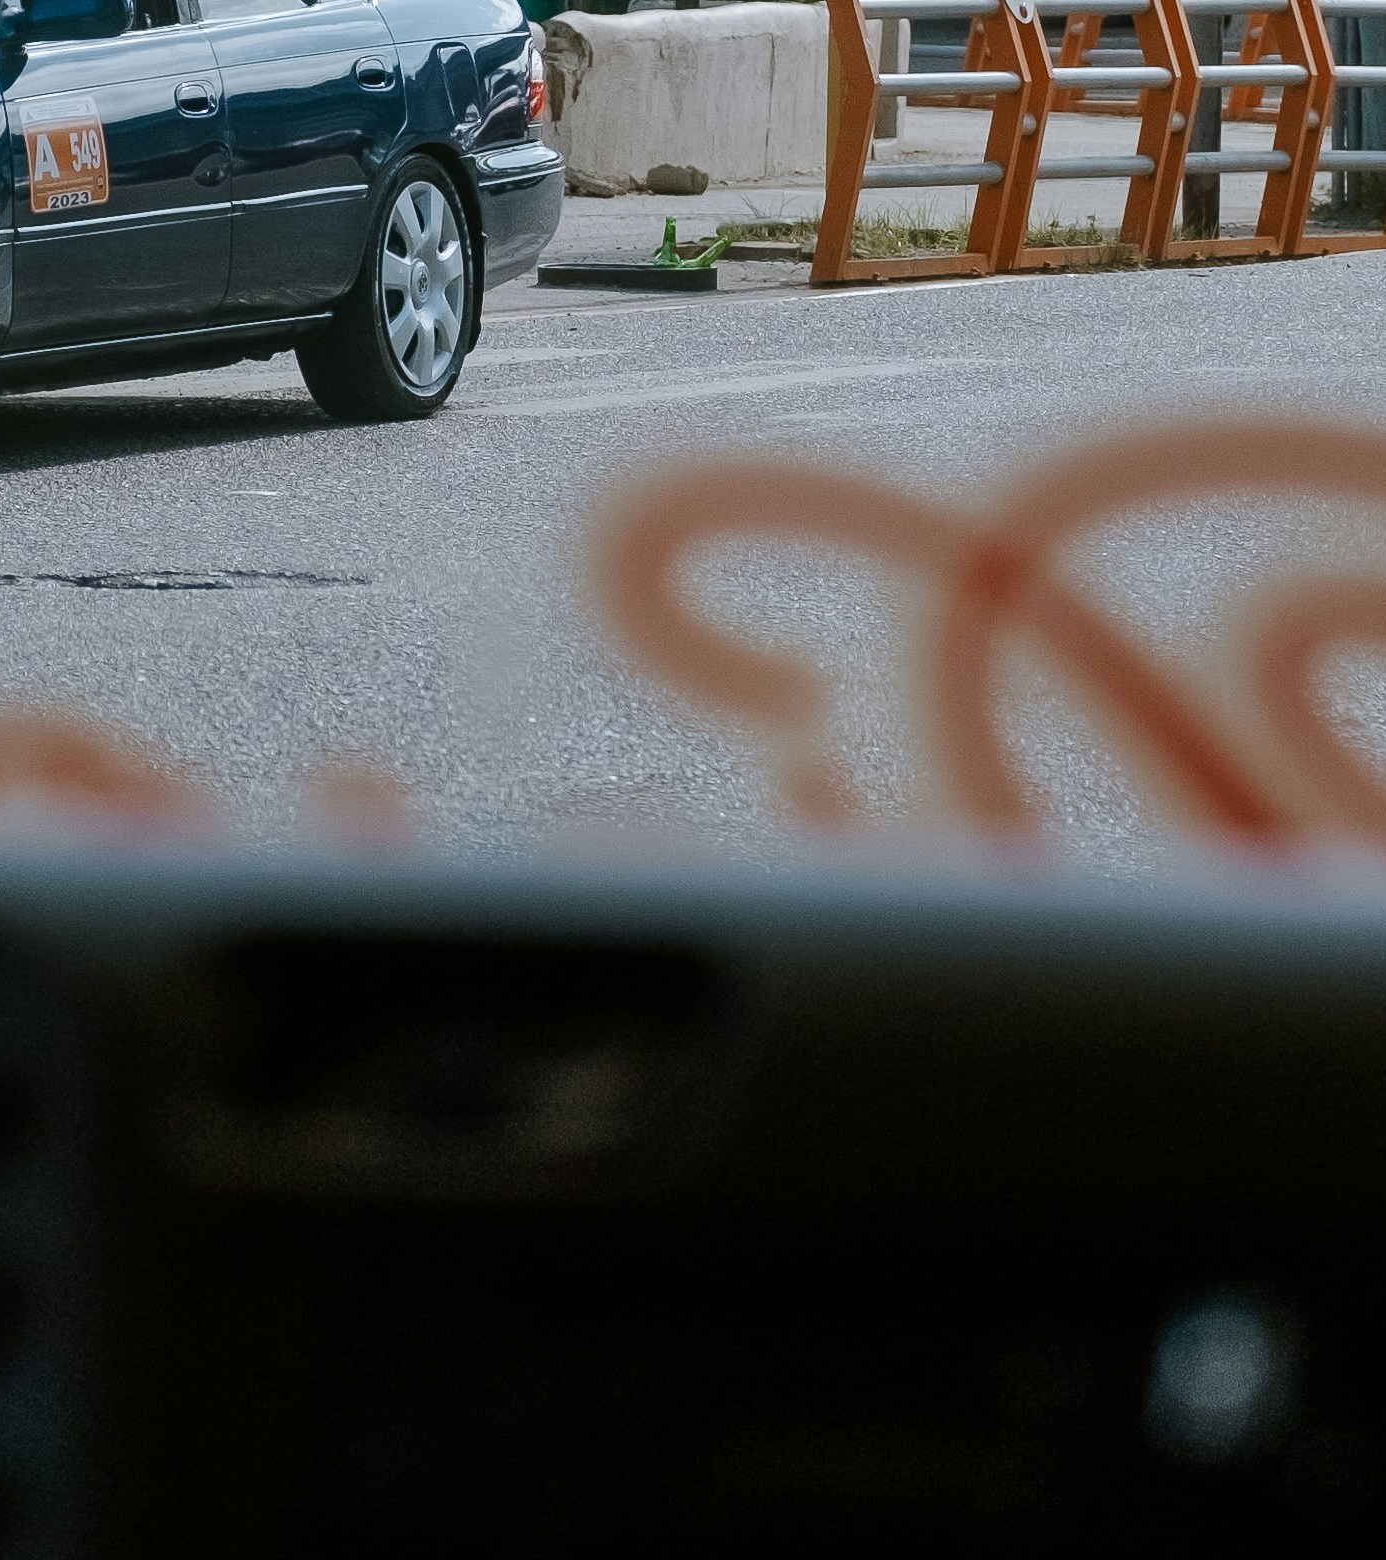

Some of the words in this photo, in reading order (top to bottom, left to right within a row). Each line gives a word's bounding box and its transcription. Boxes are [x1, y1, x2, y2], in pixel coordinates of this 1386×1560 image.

[34, 133, 61, 182] A
[68, 129, 102, 173] 549
[49, 191, 91, 210] 2023
